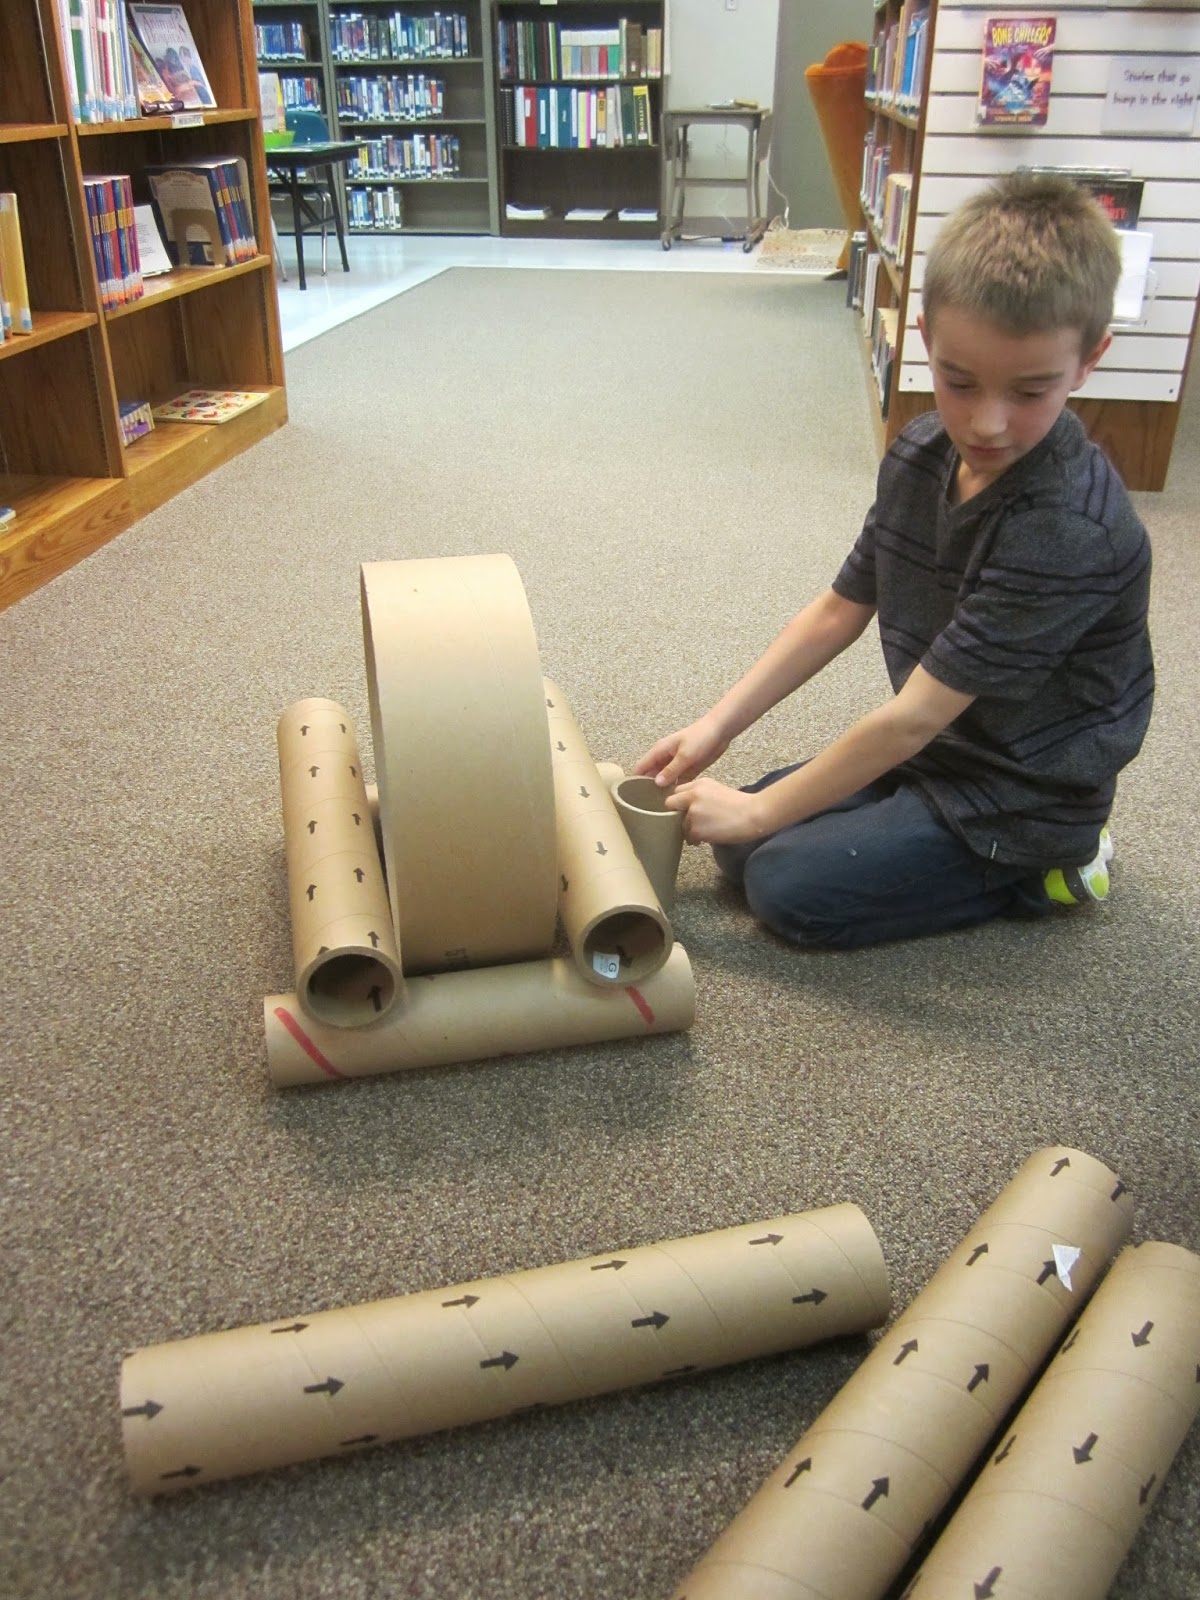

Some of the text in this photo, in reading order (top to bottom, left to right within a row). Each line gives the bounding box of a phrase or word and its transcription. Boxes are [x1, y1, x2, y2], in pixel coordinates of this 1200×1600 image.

[992, 26, 1052, 47] BONE CHILLERS
[1124, 69, 1190, 86] Stories that go
[1113, 92, 1194, 108] bump in the night
